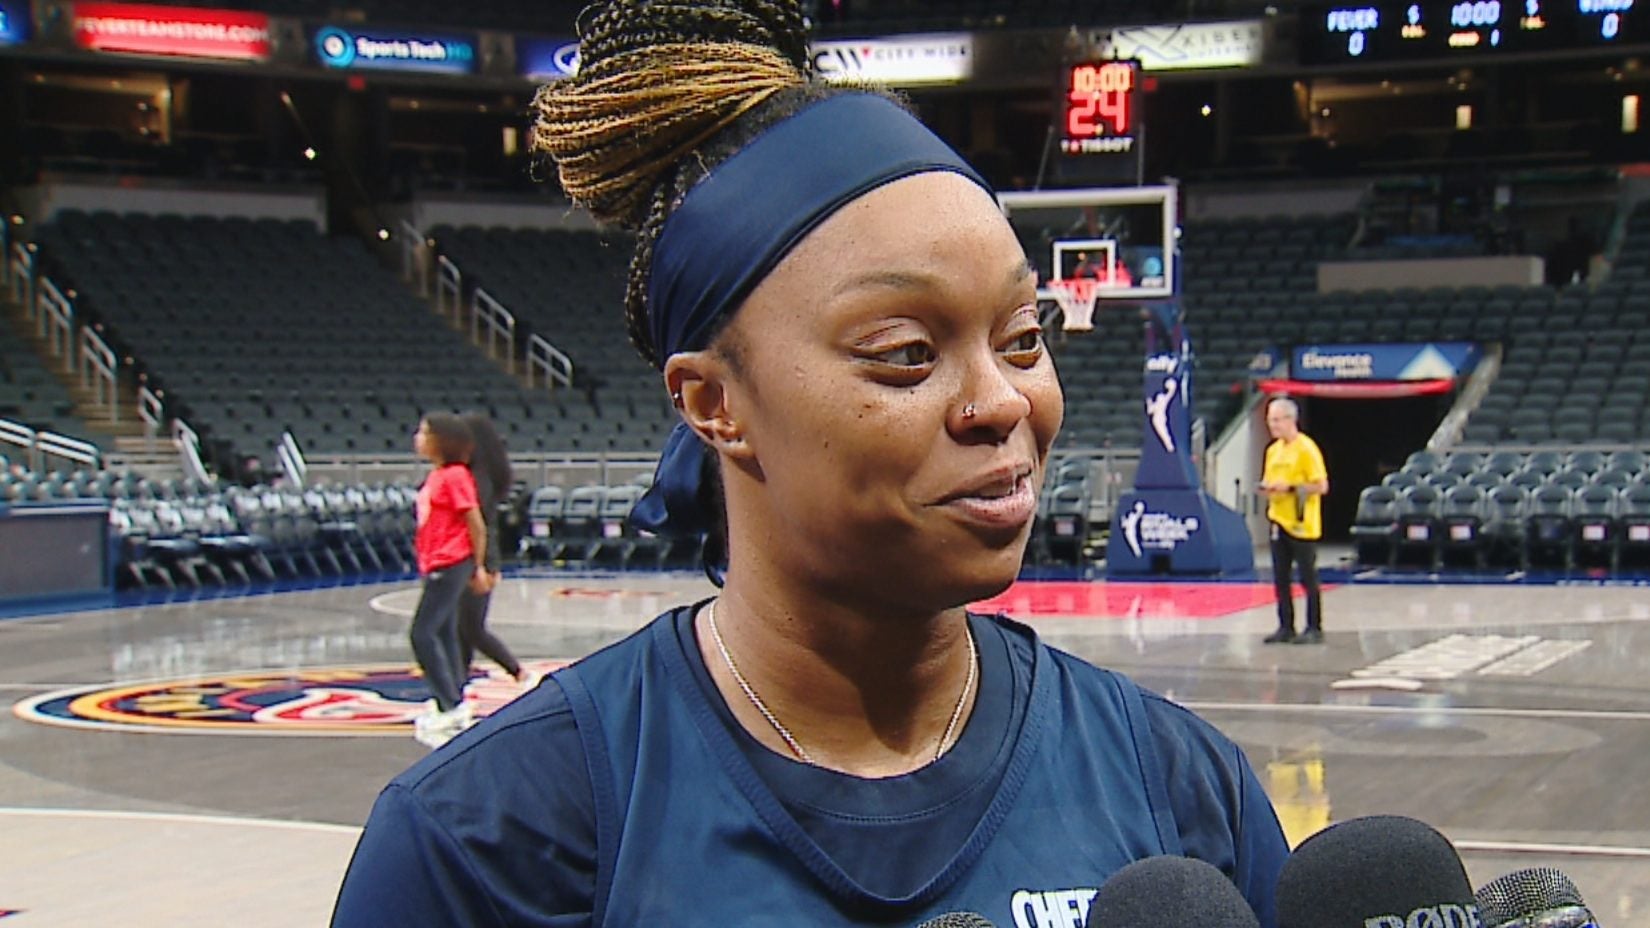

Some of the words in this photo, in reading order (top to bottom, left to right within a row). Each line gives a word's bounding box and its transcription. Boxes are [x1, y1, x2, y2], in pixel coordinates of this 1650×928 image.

[1327, 8, 1378, 32] FEVER
[1602, 12, 1619, 38] 0
[356, 36, 409, 60] Sports
[408, 40, 446, 61] Tech
[1348, 31, 1364, 56] 0
[1073, 65, 1132, 92] 10:00
[1068, 89, 1127, 136] 24
[1080, 137, 1133, 153] TISSOT
[1302, 352, 1372, 370] Elevance
